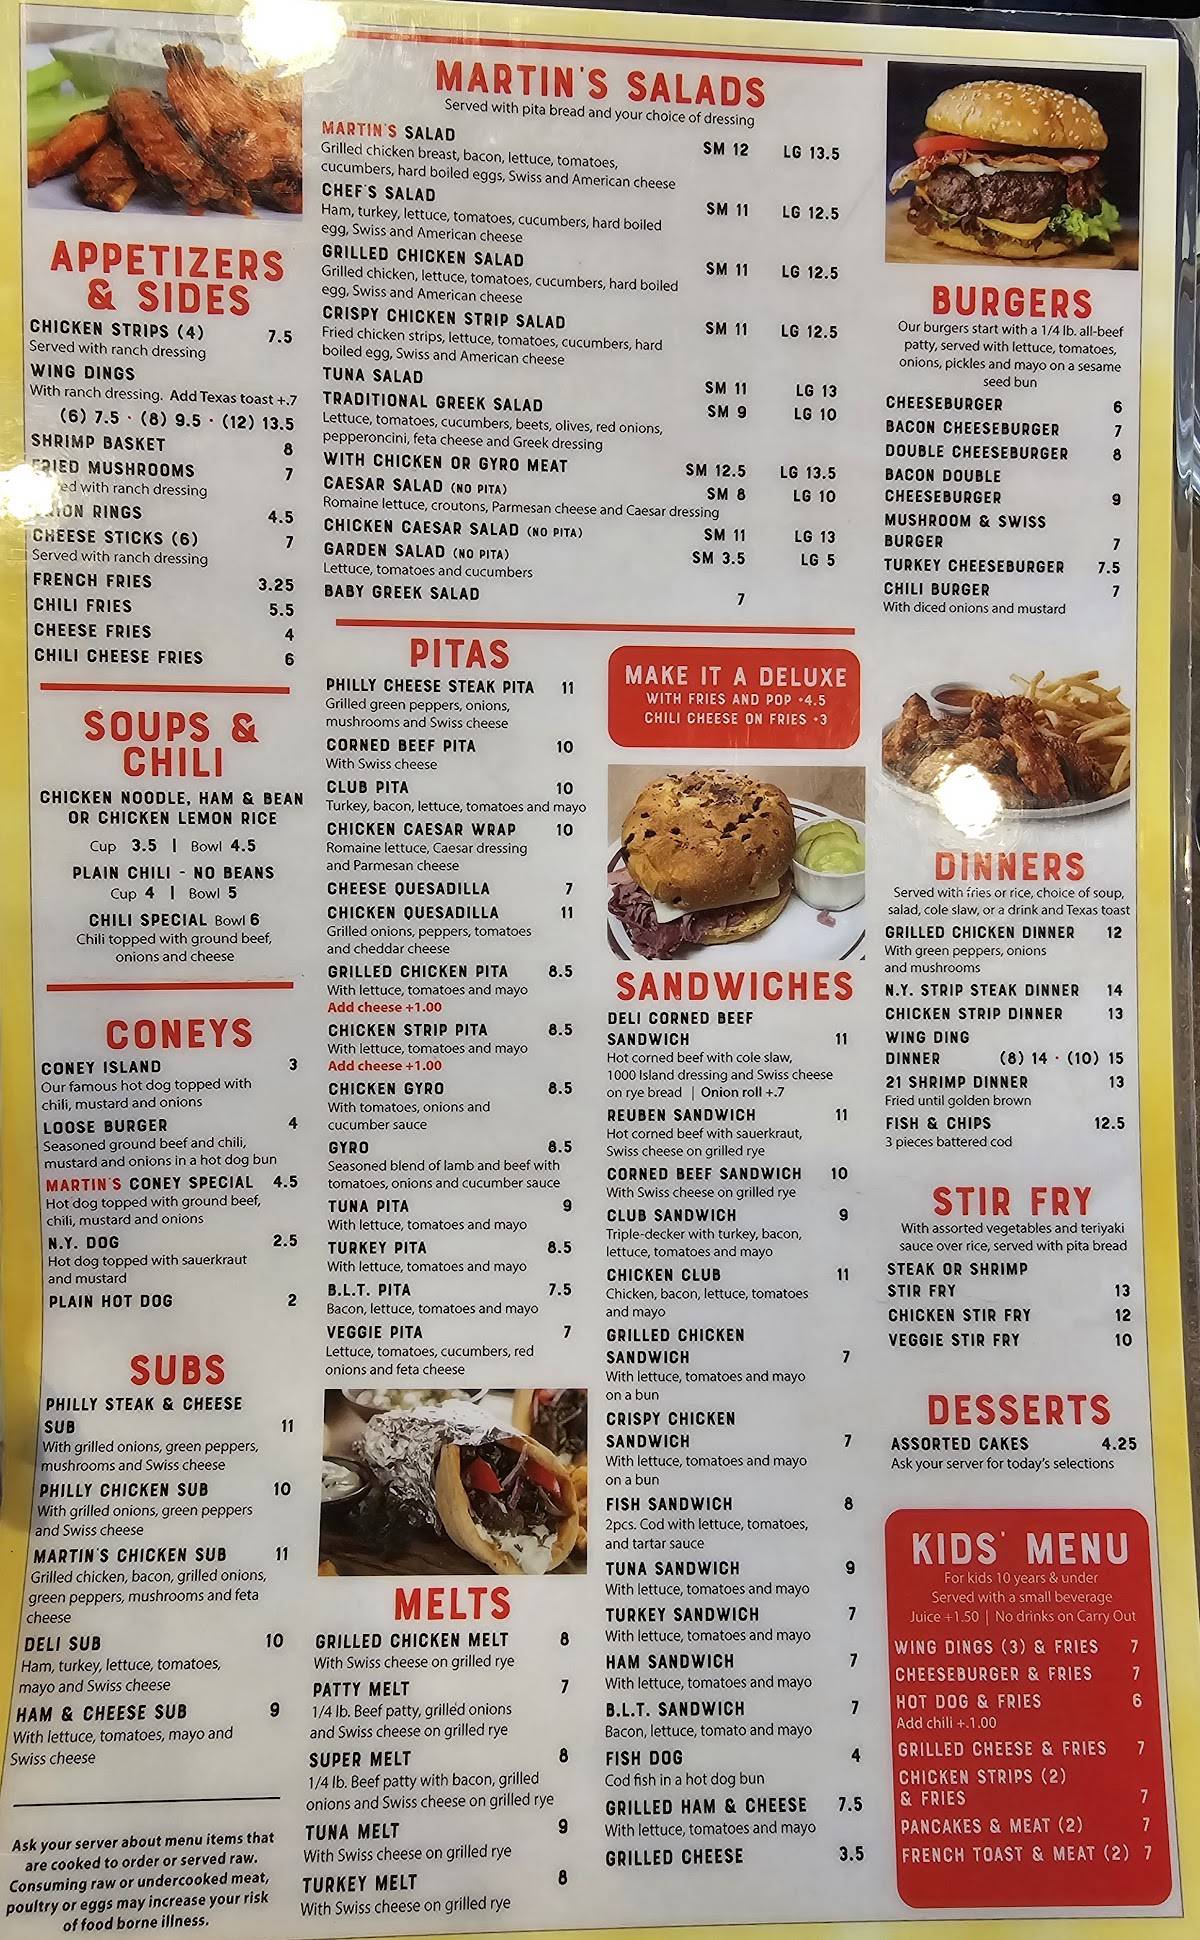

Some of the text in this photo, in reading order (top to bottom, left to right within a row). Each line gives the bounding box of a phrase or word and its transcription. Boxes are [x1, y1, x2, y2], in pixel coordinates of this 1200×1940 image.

[436, 60, 765, 108] MARTIN'S SALADS
[445, 98, 755, 129] Served with pita bread and your choice of dressing
[322, 121, 455, 141] MARTIN'S SALAD
[703, 141, 749, 156] SM 12
[784, 145, 840, 161] LG 13.5
[50, 240, 284, 282] APPETIZERS
[87, 278, 250, 316] & SIDES
[933, 285, 1092, 319] BURGERS
[30, 319, 203, 341] CHICKEN STRIPS (4)
[268, 329, 292, 344] 7.5
[898, 320, 1124, 338] Our burgers start with a 1/4 lb. all-beef
[29, 339, 206, 362] Served with ranch dressing
[30, 384, 297, 406] With ranch dressing. Add Texas toast +.7
[886, 420, 1059, 436] BACON CHEESEBURGER
[1115, 424, 1122, 437] 7
[33, 572, 152, 588] FRENCH FRIES
[258, 577, 294, 592] 3.25
[884, 582, 989, 596] CHILI BURGER
[883, 601, 1066, 615] With diced onions and mustard
[411, 638, 509, 669] PITAS
[625, 665, 846, 687] MAKE IT A DELUXE
[84, 709, 259, 743] SOUPS &
[327, 738, 476, 752] CORNED BEEF PITA
[557, 740, 573, 754] 10
[124, 746, 222, 777] CHILI
[325, 757, 437, 770] With Swiss cheese
[40, 790, 303, 806] CHICKEN NOODLE, HAM & BEAN
[935, 852, 1085, 881] DINNERS
[76, 932, 272, 948] Chili topped with ground beef,
[885, 925, 1074, 939] GRILLED CHICKEN DINNER
[1107, 926, 1122, 939] 12
[616, 971, 853, 1001] SANDWICHES
[327, 1001, 442, 1013] Add cheese +1.00
[107, 1018, 252, 1050] CONEYS
[41, 1060, 161, 1076] CONEY ISLAND
[289, 1058, 298, 1071] 3
[608, 1108, 755, 1122] REUBEN SANDWICH
[836, 1108, 847, 1121] 11
[46, 1176, 253, 1192] MARTIN'S CONEY SPECIAL
[933, 1186, 1091, 1216] STIR FRY
[901, 1222, 1124, 1237] With assorted vegetables and teriyaki
[130, 1354, 225, 1386] SUBS
[928, 1394, 1111, 1425] DESSERTS
[891, 1456, 1115, 1472] Ask your server for today's selections
[912, 1531, 1128, 1565] KIDS' MENU
[945, 1571, 1098, 1587] For kids 10 years & under
[395, 1586, 511, 1620] MELTS
[24, 1636, 101, 1652] DELI SUB
[266, 1633, 284, 1648] 10
[316, 1632, 509, 1649] GRILLED CHICKEN MELT
[560, 1631, 569, 1646] 8
[606, 1653, 734, 1669] HAM SANDWICH
[11, 1831, 274, 1855] Ask your server about menu items that
[902, 1844, 1129, 1863] FRENCH TOAST & MEAT (2)
[1144, 1845, 1152, 1860] 7
[300, 1896, 511, 1916] With Swiss cheese on grilled rye
